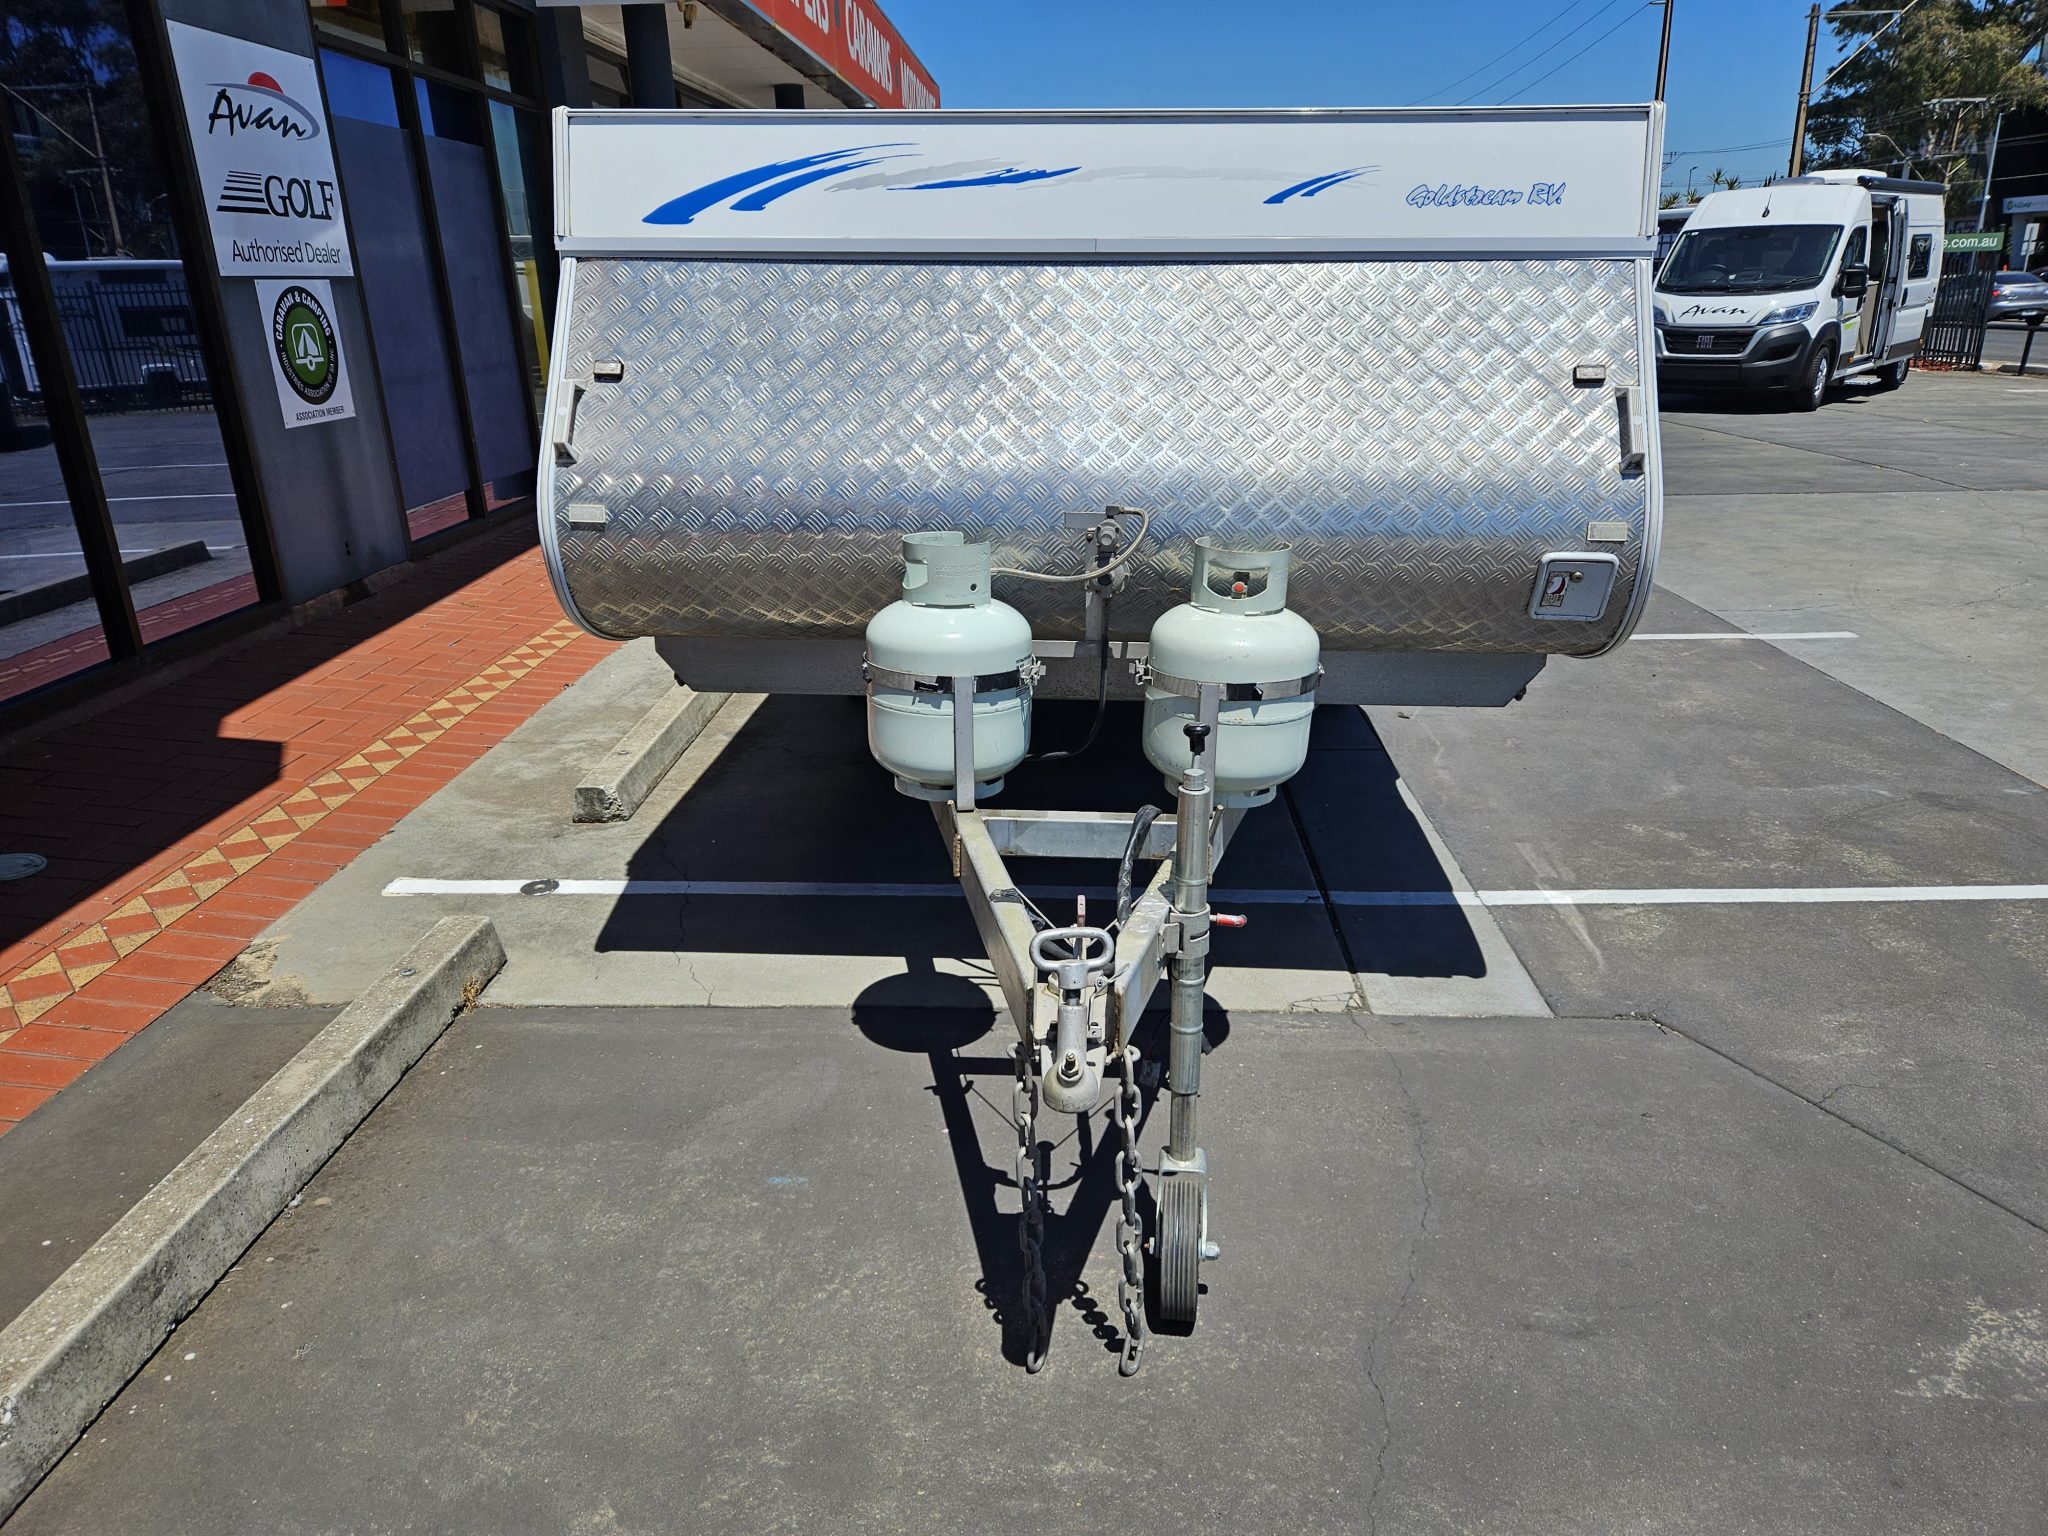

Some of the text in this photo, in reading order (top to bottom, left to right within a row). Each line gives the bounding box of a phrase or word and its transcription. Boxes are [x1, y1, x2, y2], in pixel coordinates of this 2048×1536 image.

[844, 0, 893, 96] CARAVANS
[209, 88, 307, 137] Avan
[264, 175, 335, 221] GOLF
[1406, 184, 1524, 208] Goldstream
[232, 238, 341, 264] Authorised Dealer
[275, 291, 331, 341] CARAVAN & CAMPING
[1679, 304, 1749, 318] Avan
[1696, 335, 1715, 349] FIAT
[280, 351, 305, 392] INDUSTRIES
[303, 381, 331, 398] ASSOCIATION
[296, 405, 345, 422] ASSOCIATION MEMBER
